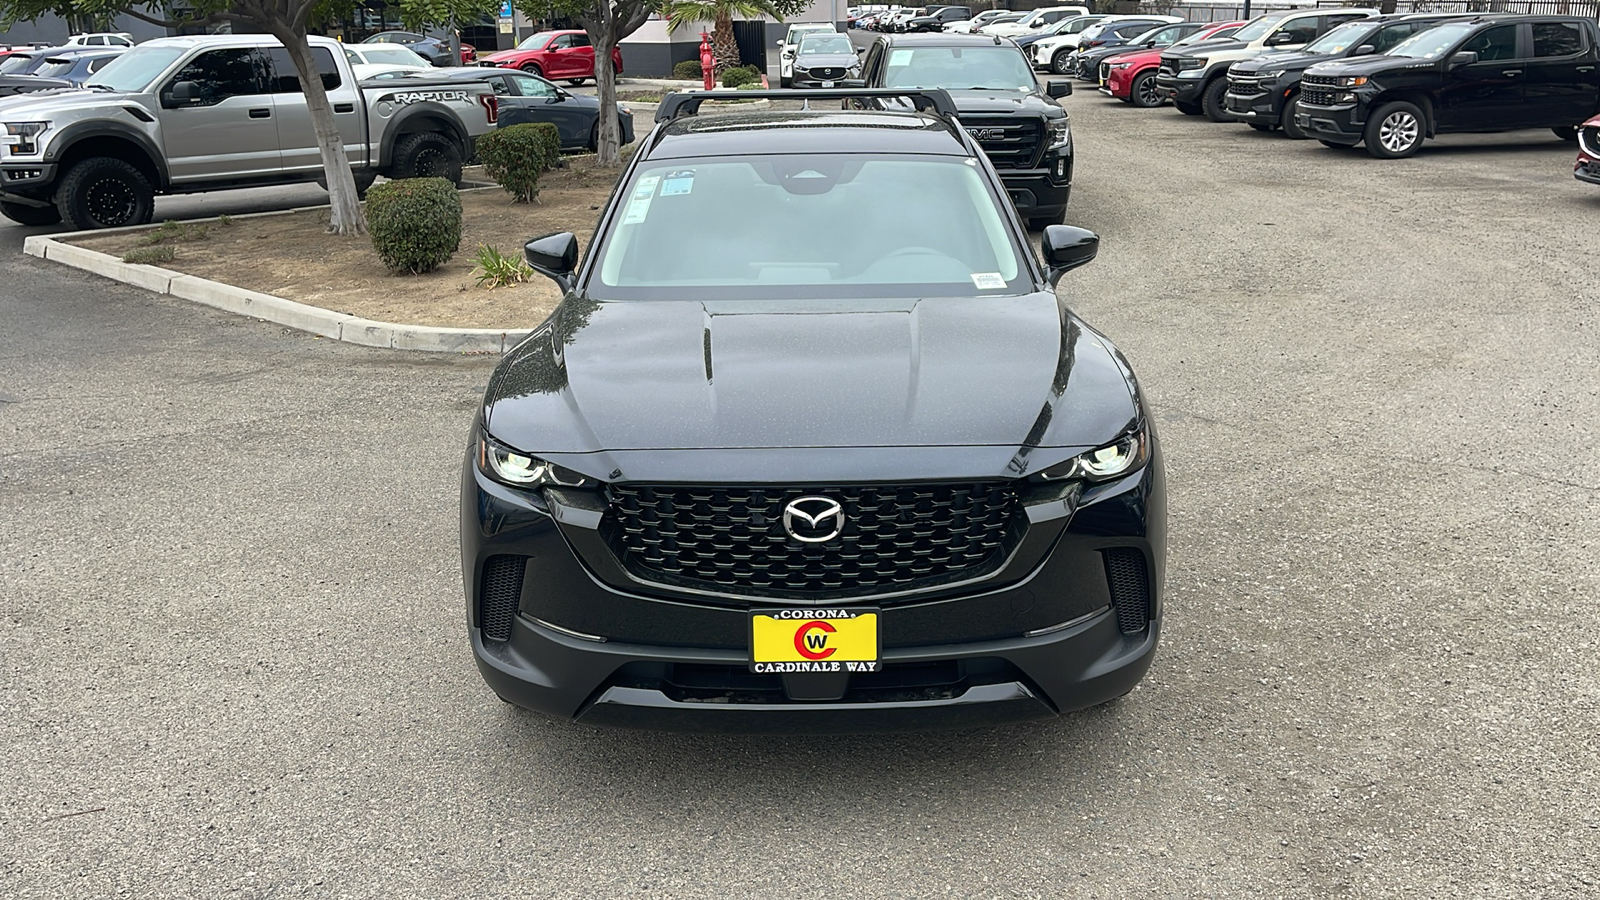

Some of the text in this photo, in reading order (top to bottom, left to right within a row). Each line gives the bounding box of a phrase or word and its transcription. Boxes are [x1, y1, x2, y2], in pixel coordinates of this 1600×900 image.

[394, 90, 474, 105] RAPTOR
[965, 128, 1005, 139] MC
[780, 609, 849, 619] CORONA
[754, 661, 877, 673] CARDINALE WAY
